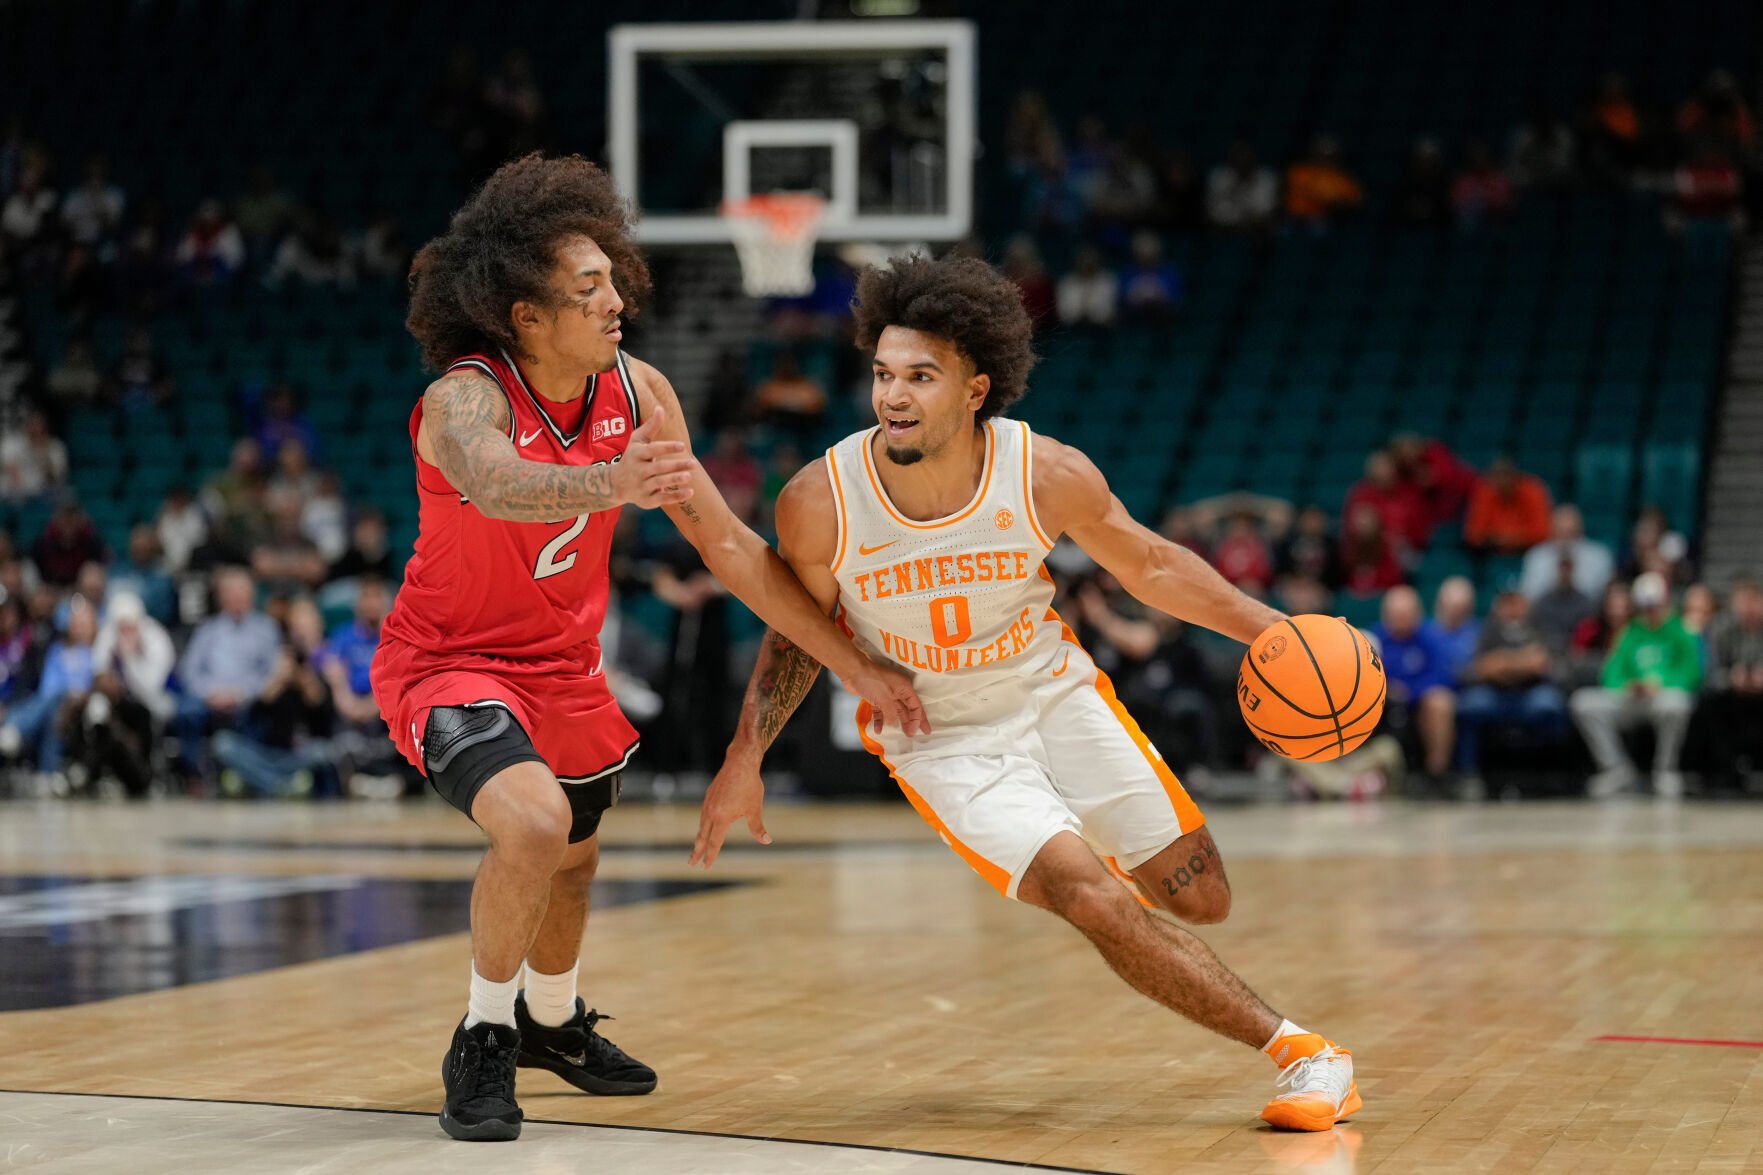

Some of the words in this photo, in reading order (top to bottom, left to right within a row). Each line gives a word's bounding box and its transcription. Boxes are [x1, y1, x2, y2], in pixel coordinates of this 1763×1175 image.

[533, 512, 591, 581] 2
[854, 551, 1029, 602] TENNESSEE
[879, 607, 1035, 673] VOLUNTEERS
[928, 595, 972, 649] 0
